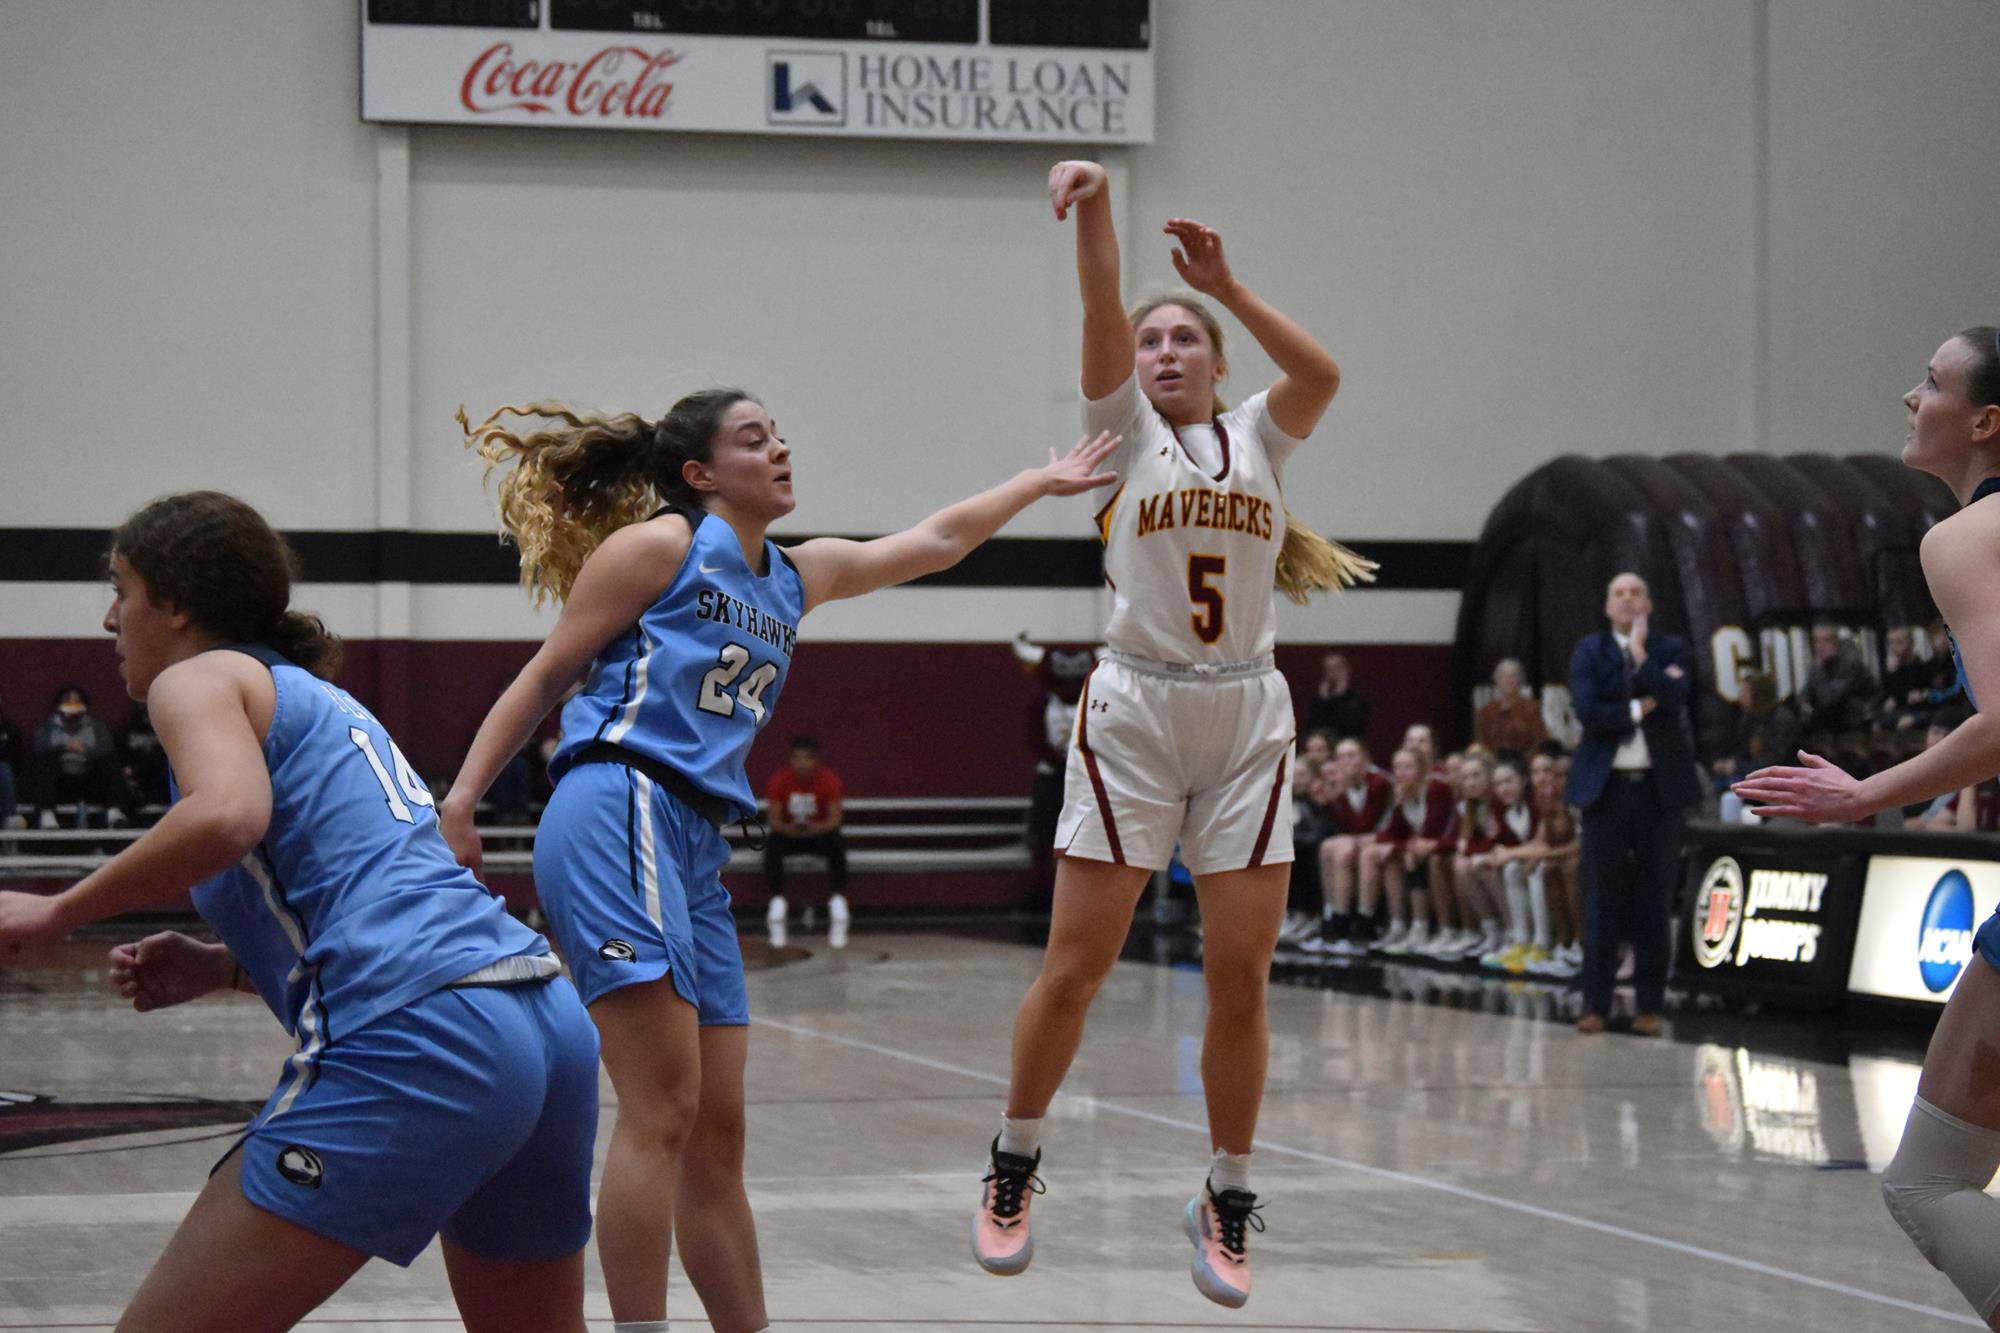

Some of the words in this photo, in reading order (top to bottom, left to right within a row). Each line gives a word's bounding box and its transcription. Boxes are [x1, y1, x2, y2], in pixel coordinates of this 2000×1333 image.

[460, 41, 688, 118] Coca-Cola
[857, 53, 993, 93] HOME
[1007, 58, 1131, 98] LOAN
[864, 92, 1127, 135] INSURANCE
[1187, 551, 1227, 647] 5
[696, 640, 780, 727] 24
[348, 725, 436, 826] 14
